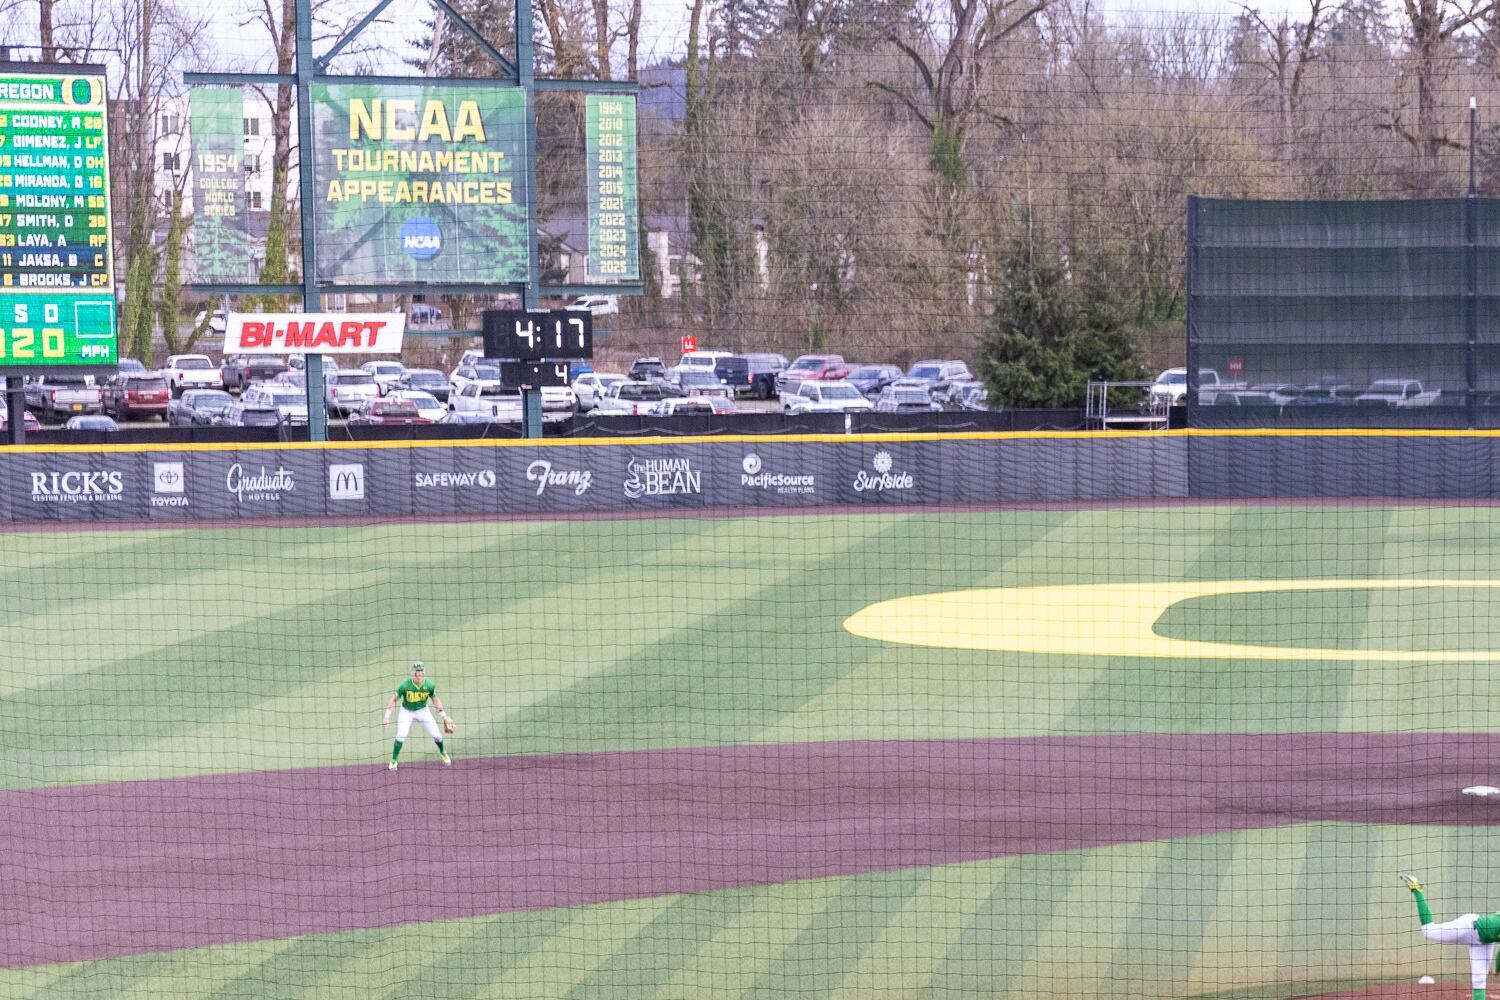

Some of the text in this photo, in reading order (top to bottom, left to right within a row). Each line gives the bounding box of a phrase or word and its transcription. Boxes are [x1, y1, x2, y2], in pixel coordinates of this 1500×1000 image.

[12, 115, 67, 129] COONEY,
[350, 98, 487, 142] NCAA
[599, 118, 622, 130] 2010
[74, 136, 81, 148] J
[86, 136, 101, 148] LF
[599, 134, 622, 146] 2012
[14, 155, 70, 169] HELLMAN,
[198, 154, 239, 172] 1954
[331, 149, 504, 173] TOURNAMENT
[599, 166, 622, 178] 2014
[15, 175, 70, 188] MIRANDA,
[200, 178, 238, 189] COLLEGE
[599, 181, 623, 194] 2015
[205, 192, 234, 202] WORLD
[327, 180, 512, 204] APPEARANCES
[16, 195, 69, 208] MOLONY,
[74, 196, 84, 207] M
[600, 197, 623, 210] 2021
[204, 205, 235, 216] SERIES
[17, 215, 60, 228] SMITH,
[18, 234, 52, 247] LAYA,
[58, 235, 67, 246] A
[404, 236, 440, 249] NCAA
[3, 254, 11, 266] 11
[19, 254, 64, 267] JAKSA,
[95, 254, 103, 266] C
[20, 274, 75, 287] BROOKS,
[79, 274, 87, 286] J
[15, 304, 58, 323] S O
[516, 319, 584, 348] 4:17
[12, 328, 34, 358] 2
[42, 328, 64, 358] 0
[82, 345, 109, 357] MPH
[646, 459, 690, 472] HUMAN
[31, 471, 123, 494] RICK'S
[227, 463, 294, 502] Graduate
[415, 472, 478, 487] SAFEWAY
[526, 460, 592, 495] Franz
[645, 470, 701, 494] BEAN
[741, 473, 815, 489] PacificSource
[854, 470, 913, 492] Surfside
[151, 497, 189, 507] TOYOTA
